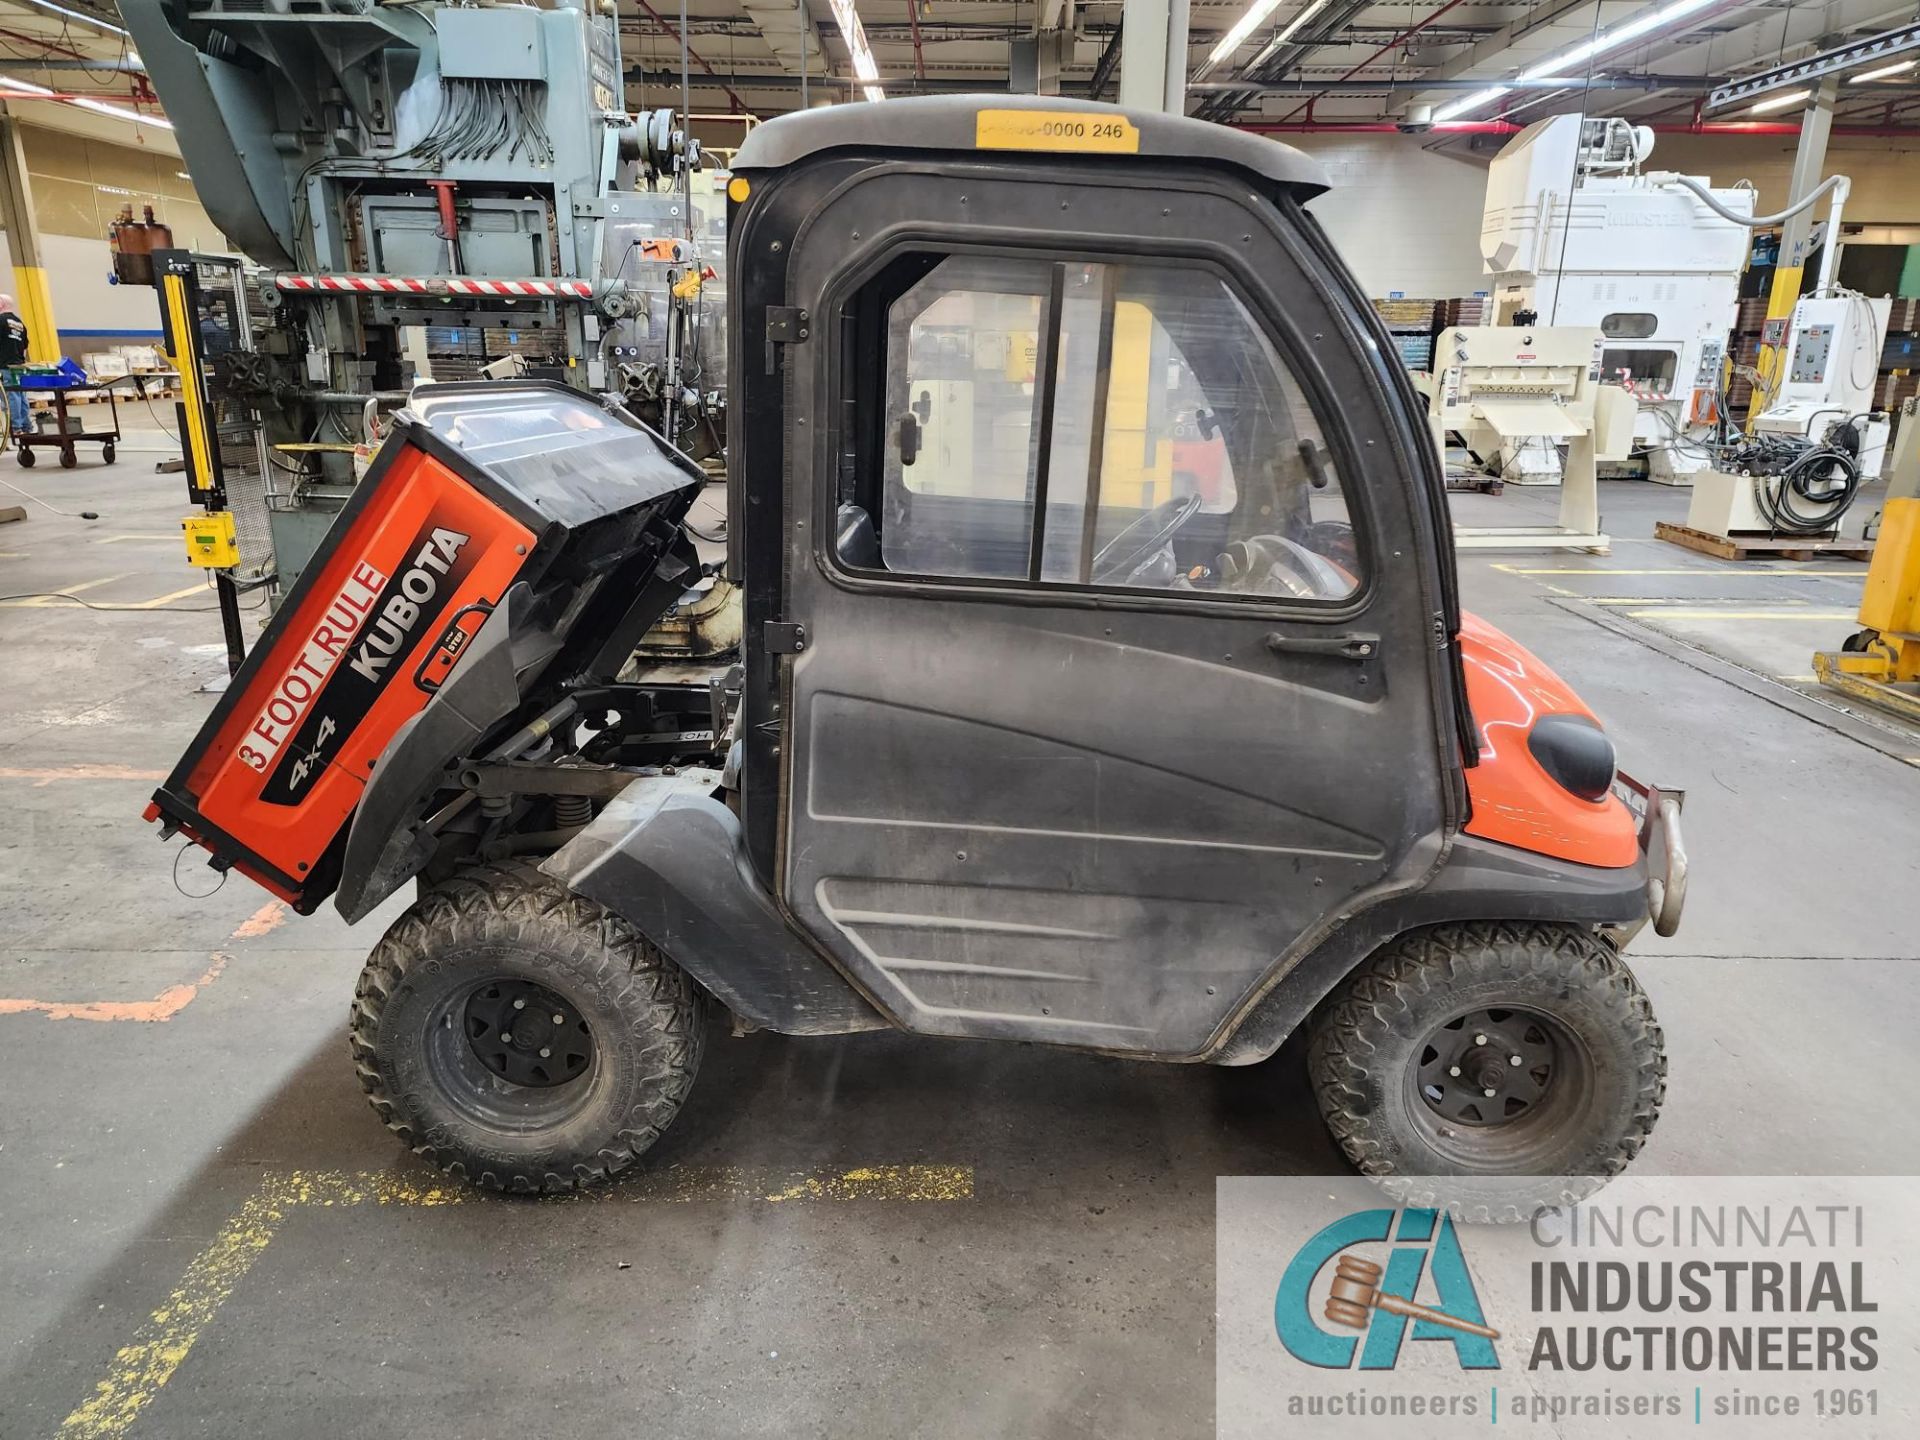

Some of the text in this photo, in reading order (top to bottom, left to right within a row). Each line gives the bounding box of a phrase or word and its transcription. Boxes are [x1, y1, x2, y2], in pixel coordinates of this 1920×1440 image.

[1092, 123, 1123, 139] 246
[1793, 240, 1804, 253] M
[350, 527, 471, 684] KUBOTA
[448, 631, 463, 652] STEP
[238, 562, 388, 770] 3 FOOT RULE
